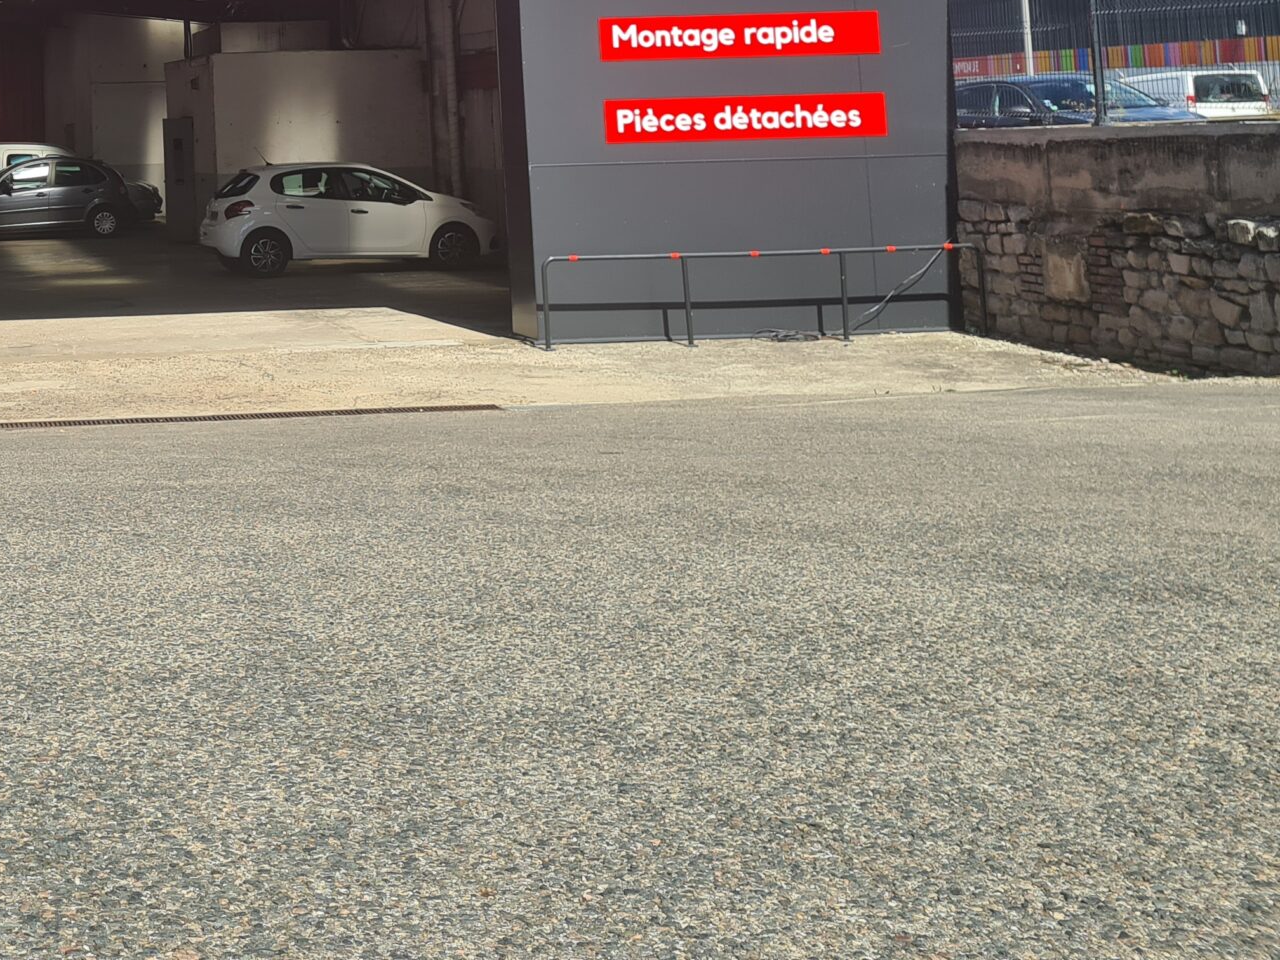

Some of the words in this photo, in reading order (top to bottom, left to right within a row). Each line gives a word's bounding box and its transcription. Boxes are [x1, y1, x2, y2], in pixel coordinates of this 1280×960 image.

[611, 23, 736, 52] Montage
[743, 18, 836, 50] rapide
[615, 108, 707, 134] Pièces
[713, 104, 862, 131] détachées
